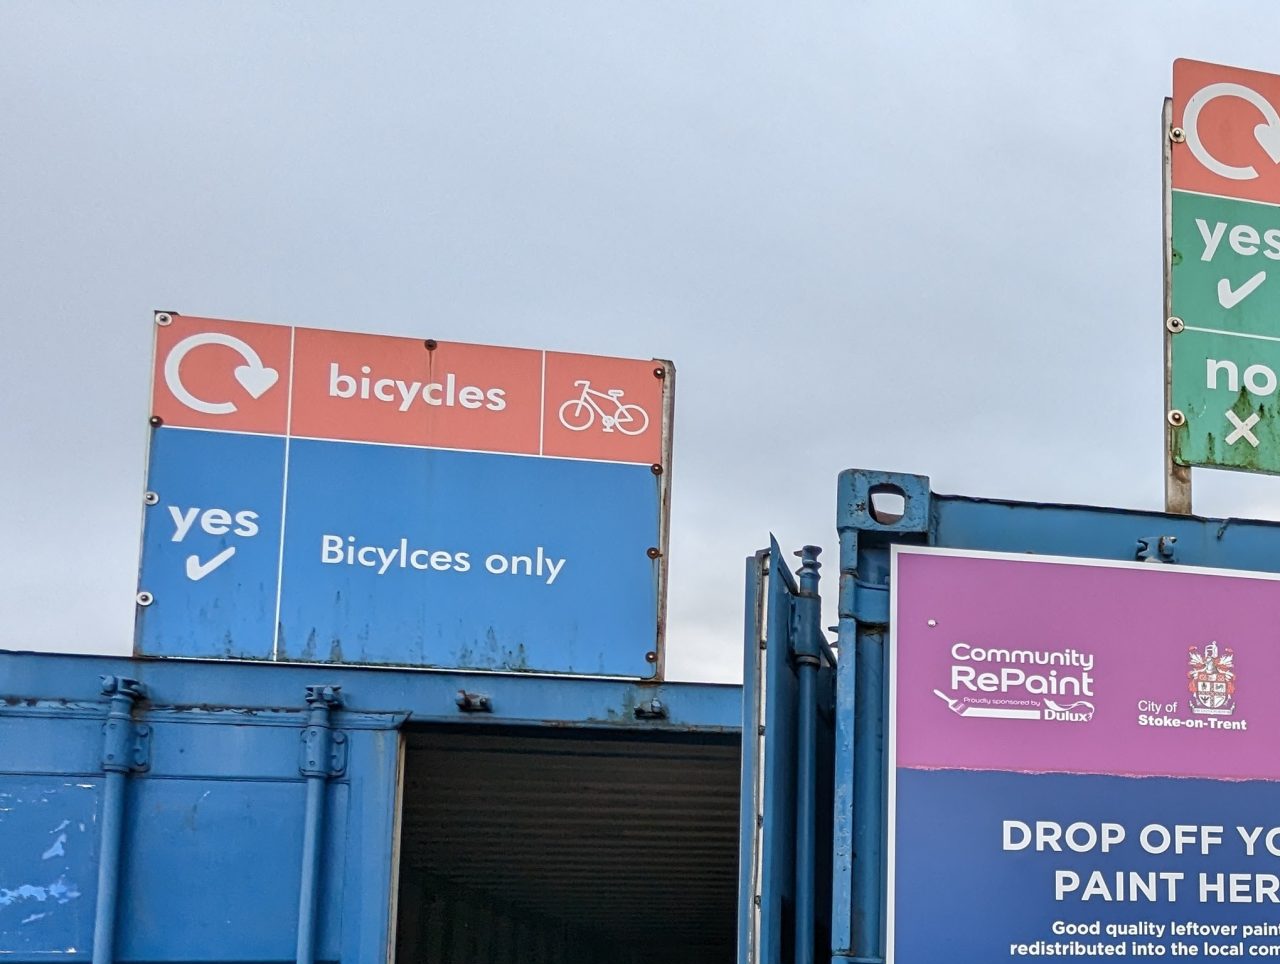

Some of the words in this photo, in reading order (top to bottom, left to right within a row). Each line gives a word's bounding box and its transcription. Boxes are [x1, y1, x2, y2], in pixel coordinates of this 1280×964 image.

[329, 363, 506, 411] bicycles
[1207, 359, 1277, 396] no
[168, 506, 258, 542] yes
[322, 535, 470, 574] Bicylces
[485, 547, 566, 584] only
[951, 643, 1094, 671] Community
[951, 665, 1094, 697] RePaint
[1044, 709, 1087, 721] Dulux
[1138, 700, 1162, 714] City
[1165, 702, 1177, 712] of
[1138, 714, 1247, 730] Stoke-on-Trent
[1003, 820, 1125, 852] DROP
[1140, 824, 1223, 854] OFF
[1055, 870, 1184, 902] PAINT
[1052, 921, 1100, 935] Good
[1106, 921, 1165, 938] quality
[1171, 922, 1237, 935] leftover
[1010, 941, 1126, 955] redistributed
[1132, 942, 1165, 955] into
[1171, 942, 1198, 955] the
[1204, 942, 1243, 956] local
